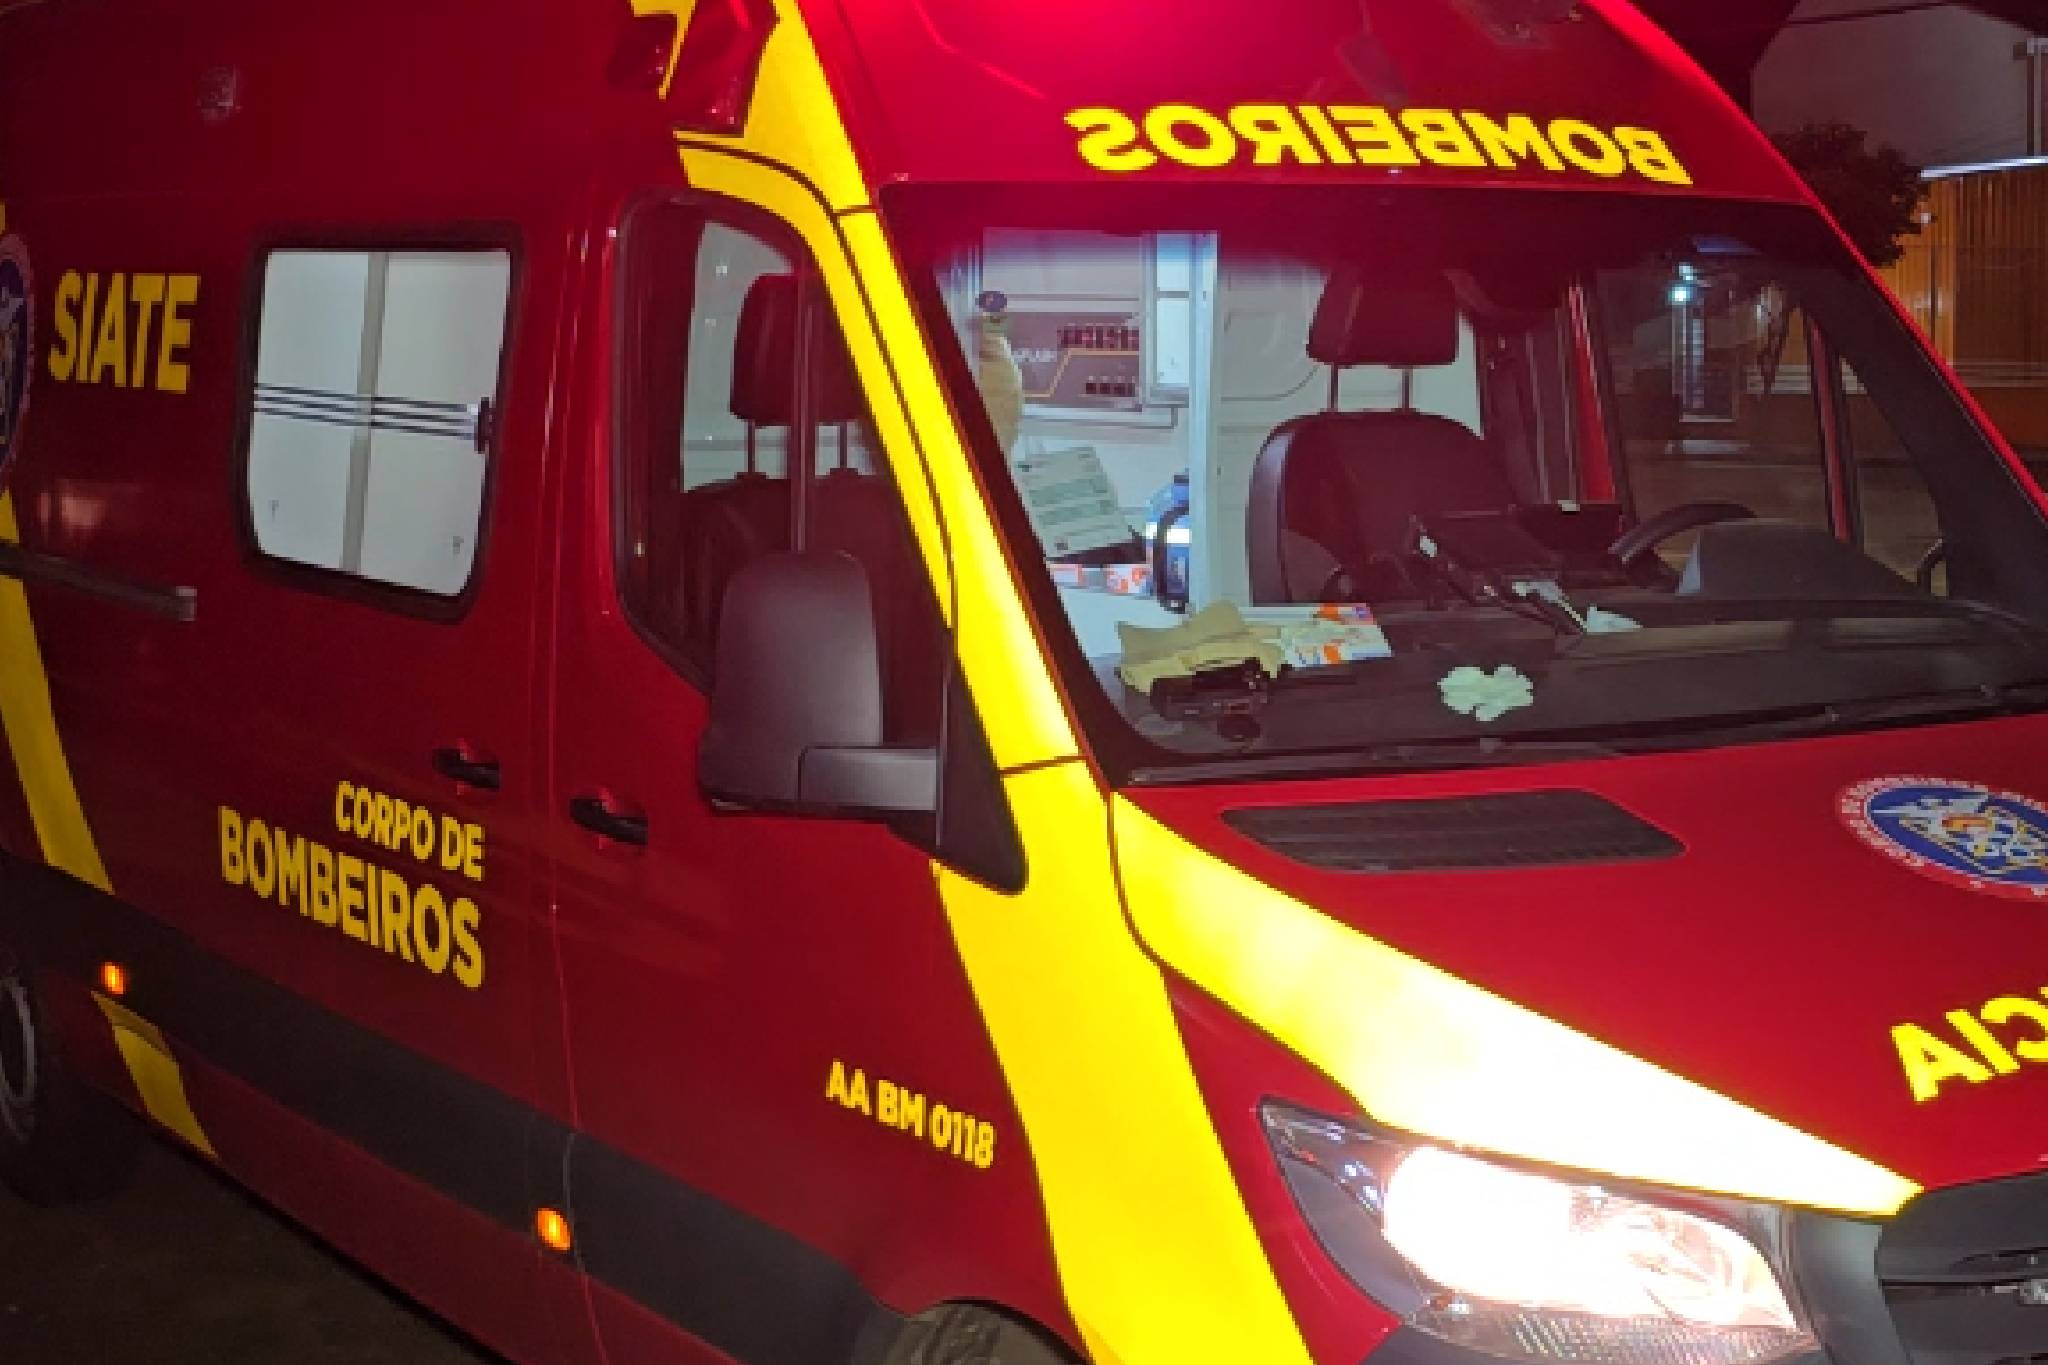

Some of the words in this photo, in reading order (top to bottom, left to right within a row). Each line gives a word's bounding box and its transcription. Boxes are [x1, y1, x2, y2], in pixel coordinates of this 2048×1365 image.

[48, 269, 200, 393] SIATE
[335, 780, 435, 860] CORPO
[441, 814, 485, 881] DE
[219, 805, 485, 989] BOMBEIROS
[826, 1059, 872, 1116] AA
[877, 1079, 927, 1138] BM
[930, 1103, 995, 1169] 0118
